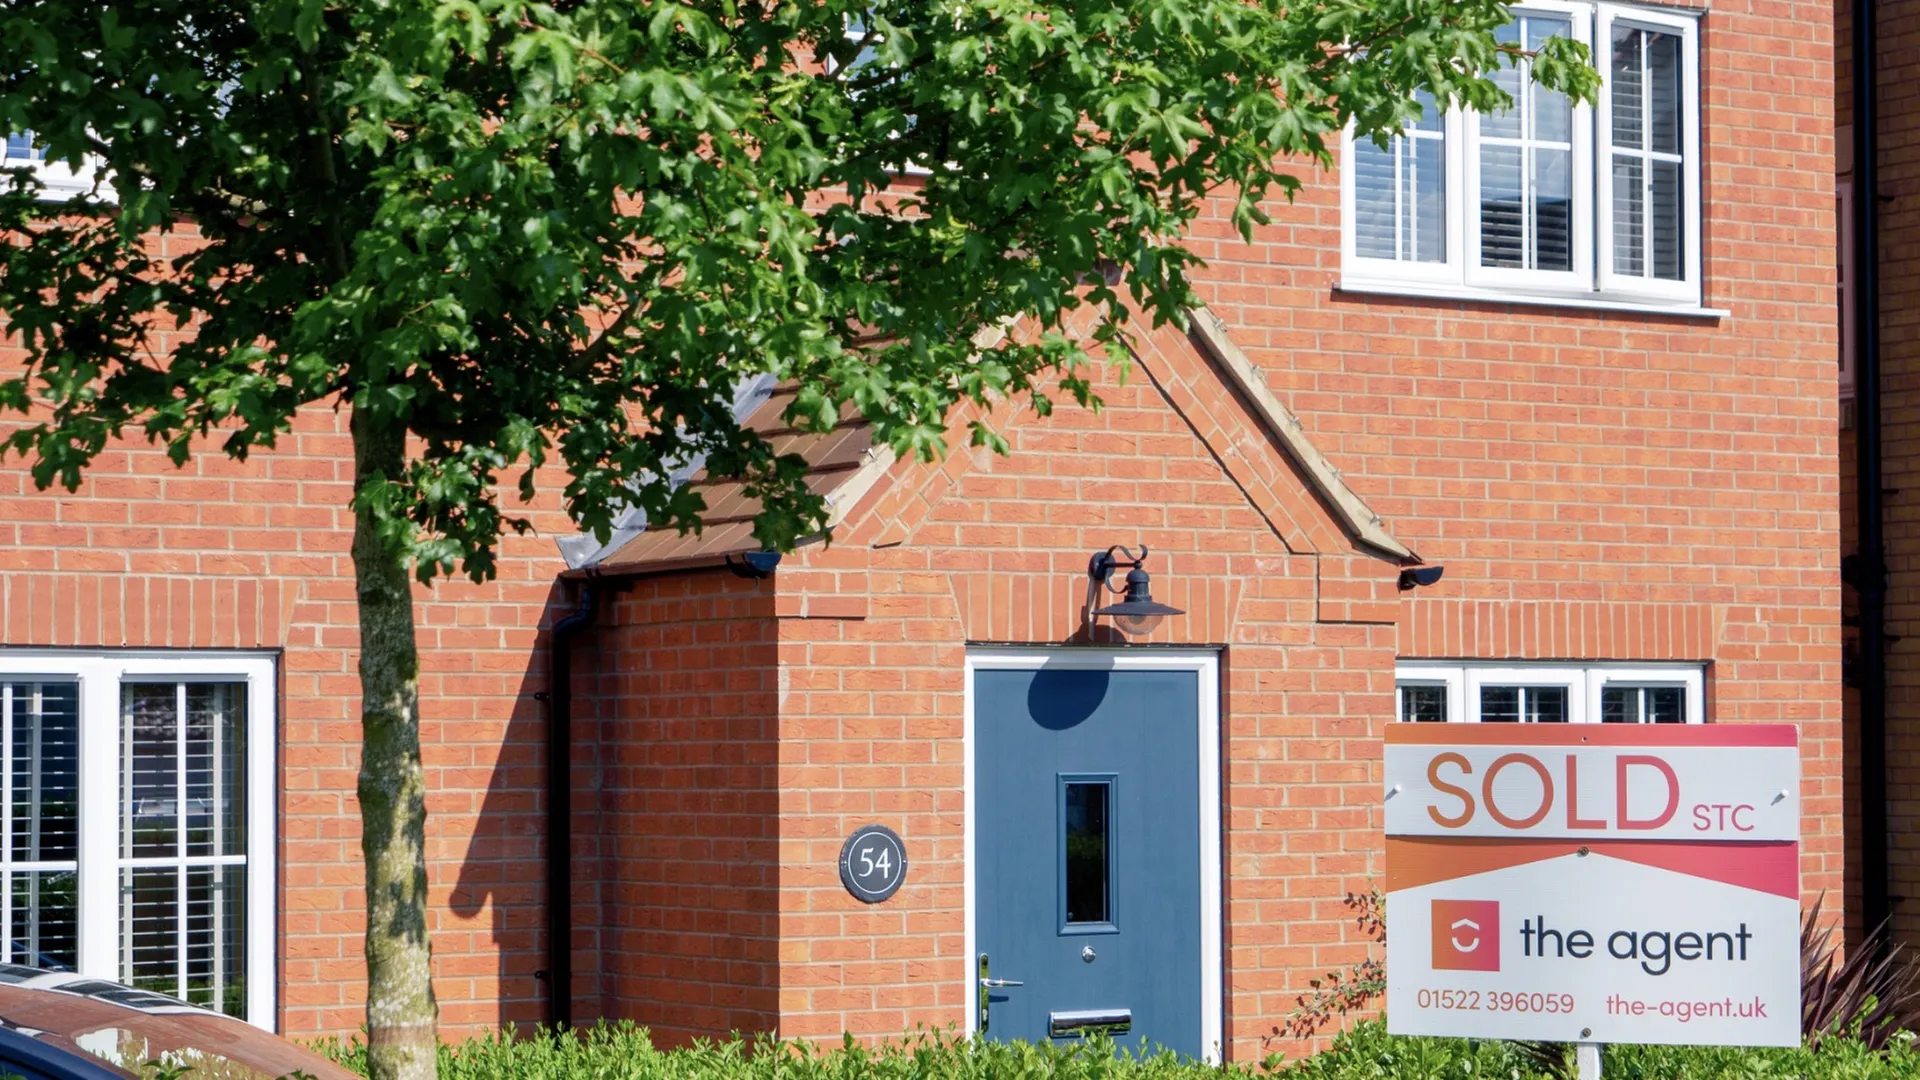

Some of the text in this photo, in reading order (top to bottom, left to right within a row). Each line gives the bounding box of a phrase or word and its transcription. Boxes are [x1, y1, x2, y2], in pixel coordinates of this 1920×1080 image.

[1427, 752, 1755, 832] SOLD STC
[858, 847, 892, 879] 54
[1519, 915, 1753, 976] the agent
[1416, 989, 1575, 1014] 01522 396059
[1606, 994, 1768, 1023] the-agent.uk
